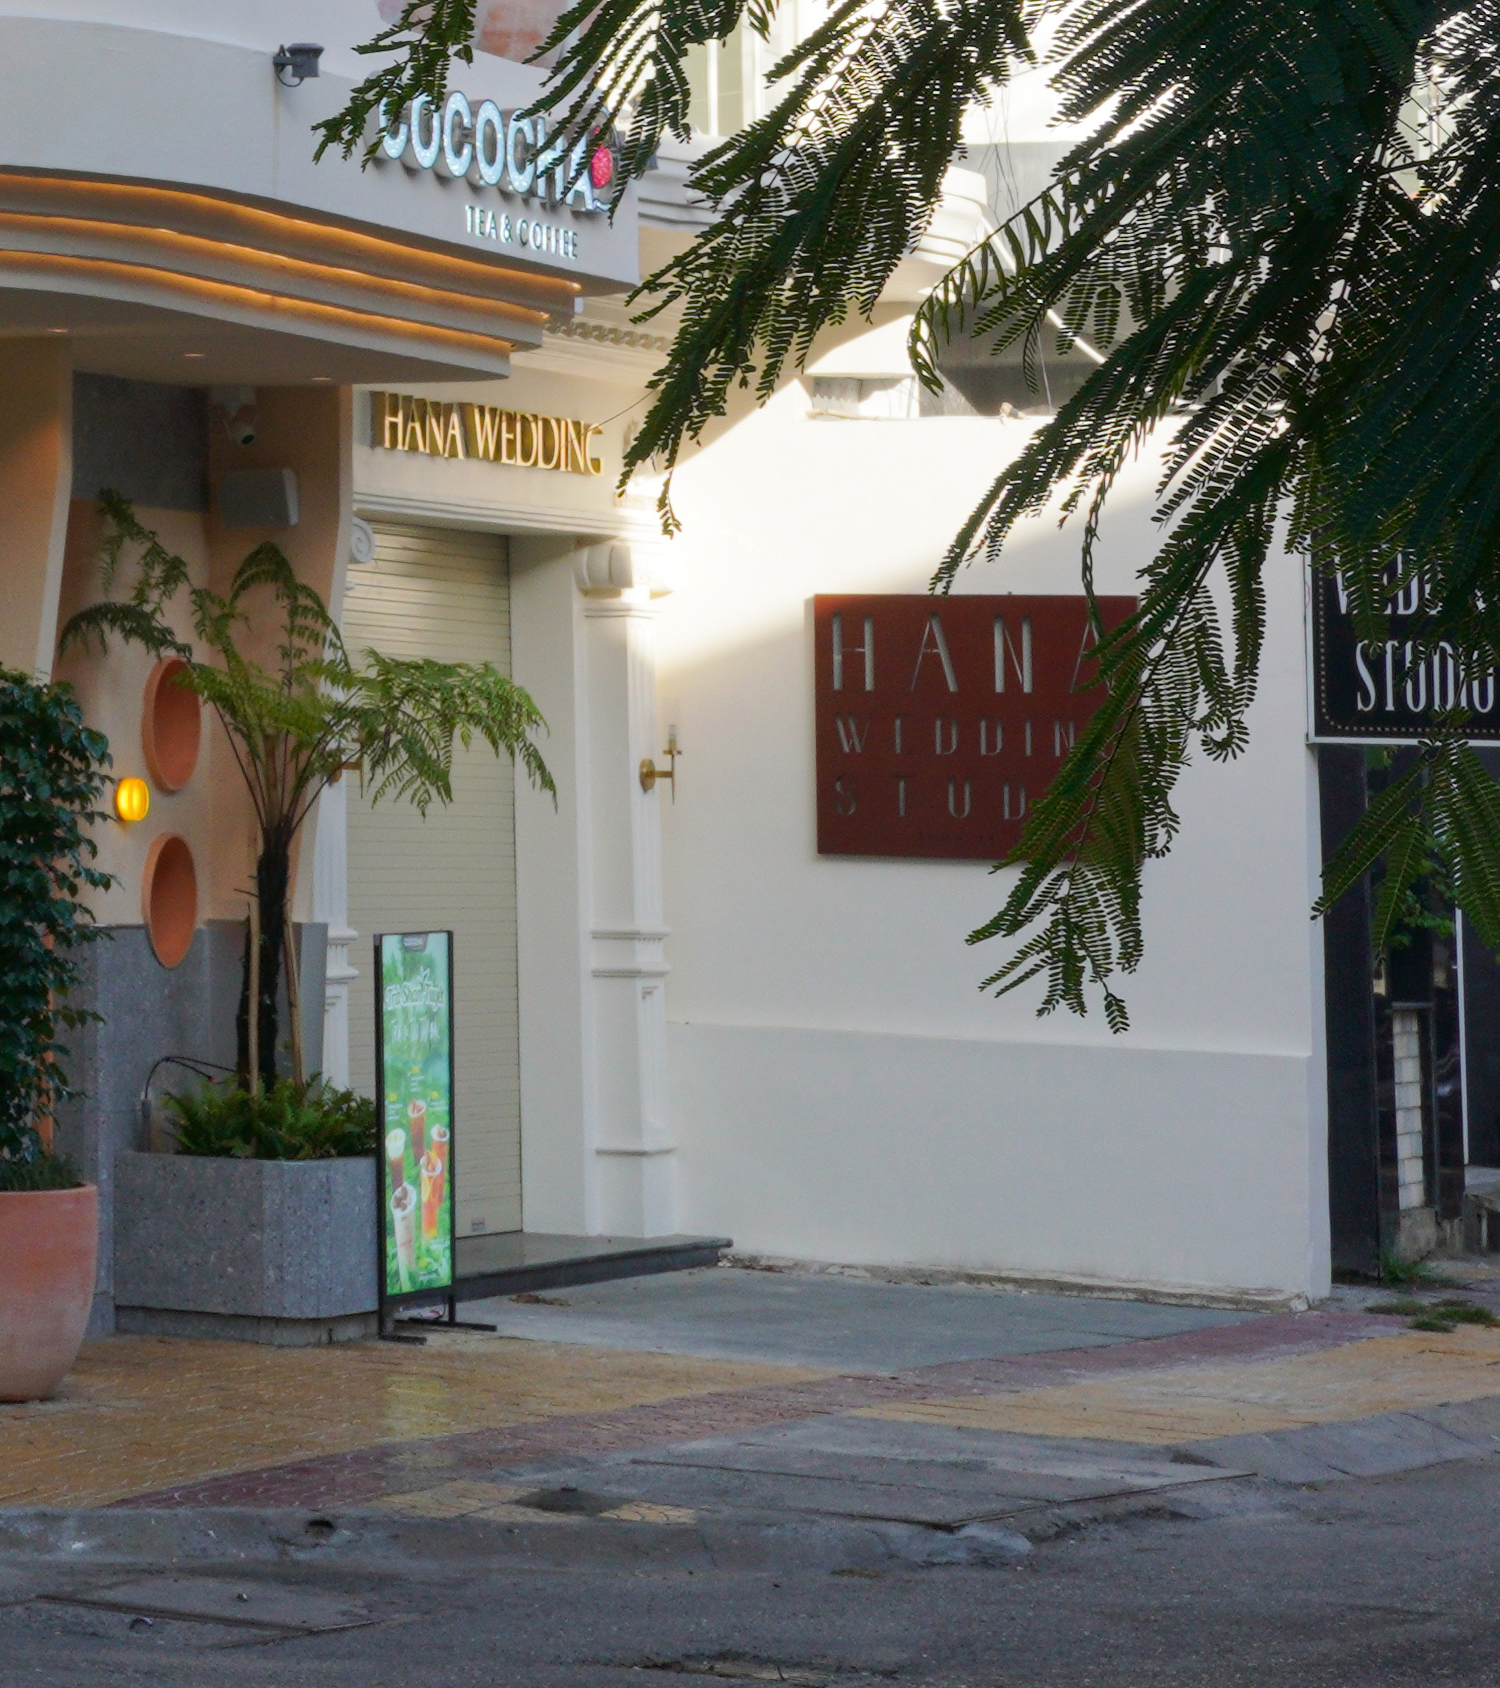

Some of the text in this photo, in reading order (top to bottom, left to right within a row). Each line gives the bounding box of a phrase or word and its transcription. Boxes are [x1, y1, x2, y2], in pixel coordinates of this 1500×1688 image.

[465, 205, 579, 260] TEA & COFFEE
[384, 392, 605, 476] HANA WEDDING
